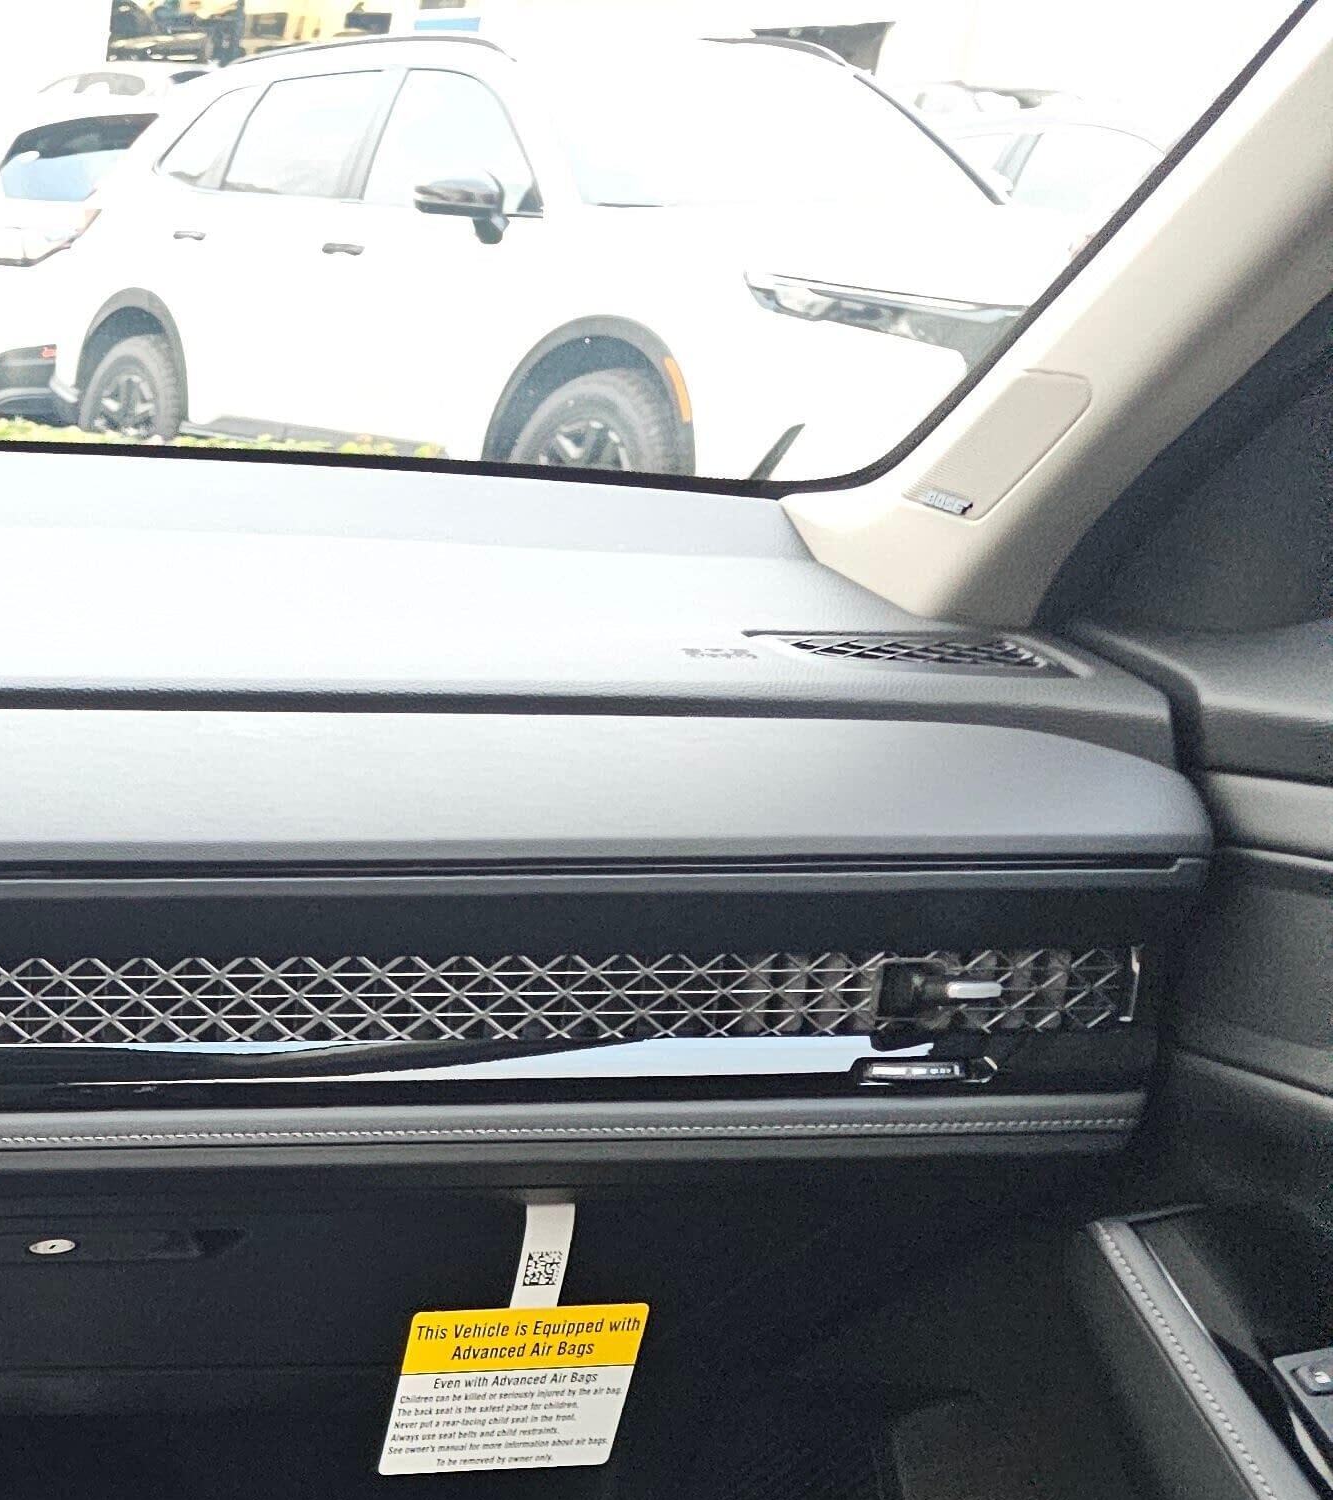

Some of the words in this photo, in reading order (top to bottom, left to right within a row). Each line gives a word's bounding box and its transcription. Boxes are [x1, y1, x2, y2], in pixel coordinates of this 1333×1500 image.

[417, 1325, 448, 1340] This
[454, 1322, 509, 1338] Vehicle
[515, 1321, 527, 1336] is
[533, 1318, 604, 1337] Equipped
[610, 1317, 640, 1331] with
[451, 1346, 526, 1361] Advanced
[530, 1342, 552, 1356] Air
[557, 1341, 594, 1358] Bags
[434, 1378, 460, 1389] Even
[465, 1377, 489, 1387] with
[491, 1373, 547, 1386] Advanced
[550, 1373, 567, 1383] Air
[571, 1372, 598, 1384] Bags
[400, 1395, 433, 1404] Children
[464, 1392, 486, 1400] killed
[415, 1408, 432, 1416] back
[420, 1421, 433, 1429] put
[489, 1417, 509, 1425] child
[392, 1434, 419, 1442] Always
[497, 1429, 517, 1437] child
